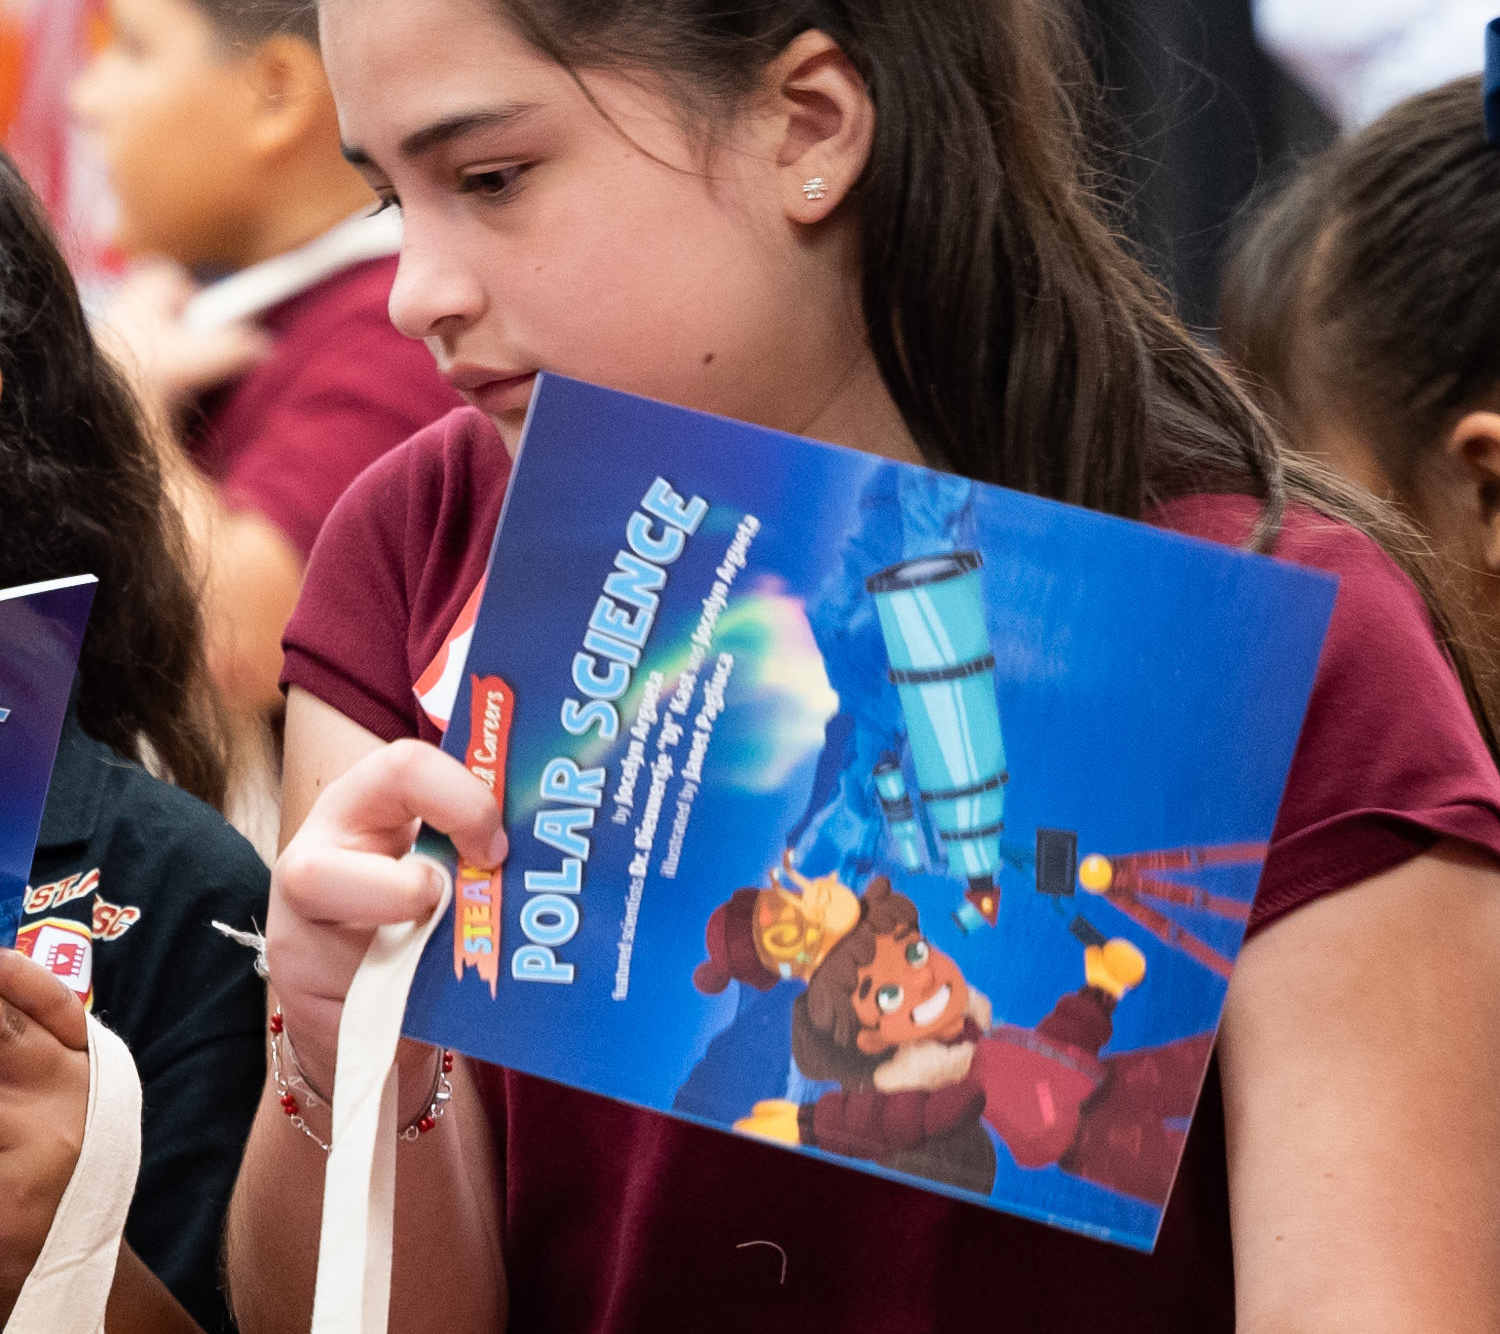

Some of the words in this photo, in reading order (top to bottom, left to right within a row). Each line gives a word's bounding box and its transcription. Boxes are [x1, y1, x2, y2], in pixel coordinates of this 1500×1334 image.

[669, 671, 696, 715] Kast
[691, 581, 729, 648] Jocelyn
[716, 514, 761, 584] Argueta
[473, 690, 504, 763] Careers
[510, 756, 605, 985] POLAR
[561, 475, 708, 742] SCIENCE
[630, 671, 663, 742] Argueta
[613, 740, 646, 808] Jocelyn
[681, 729, 711, 783] Janet
[612, 805, 631, 825] by
